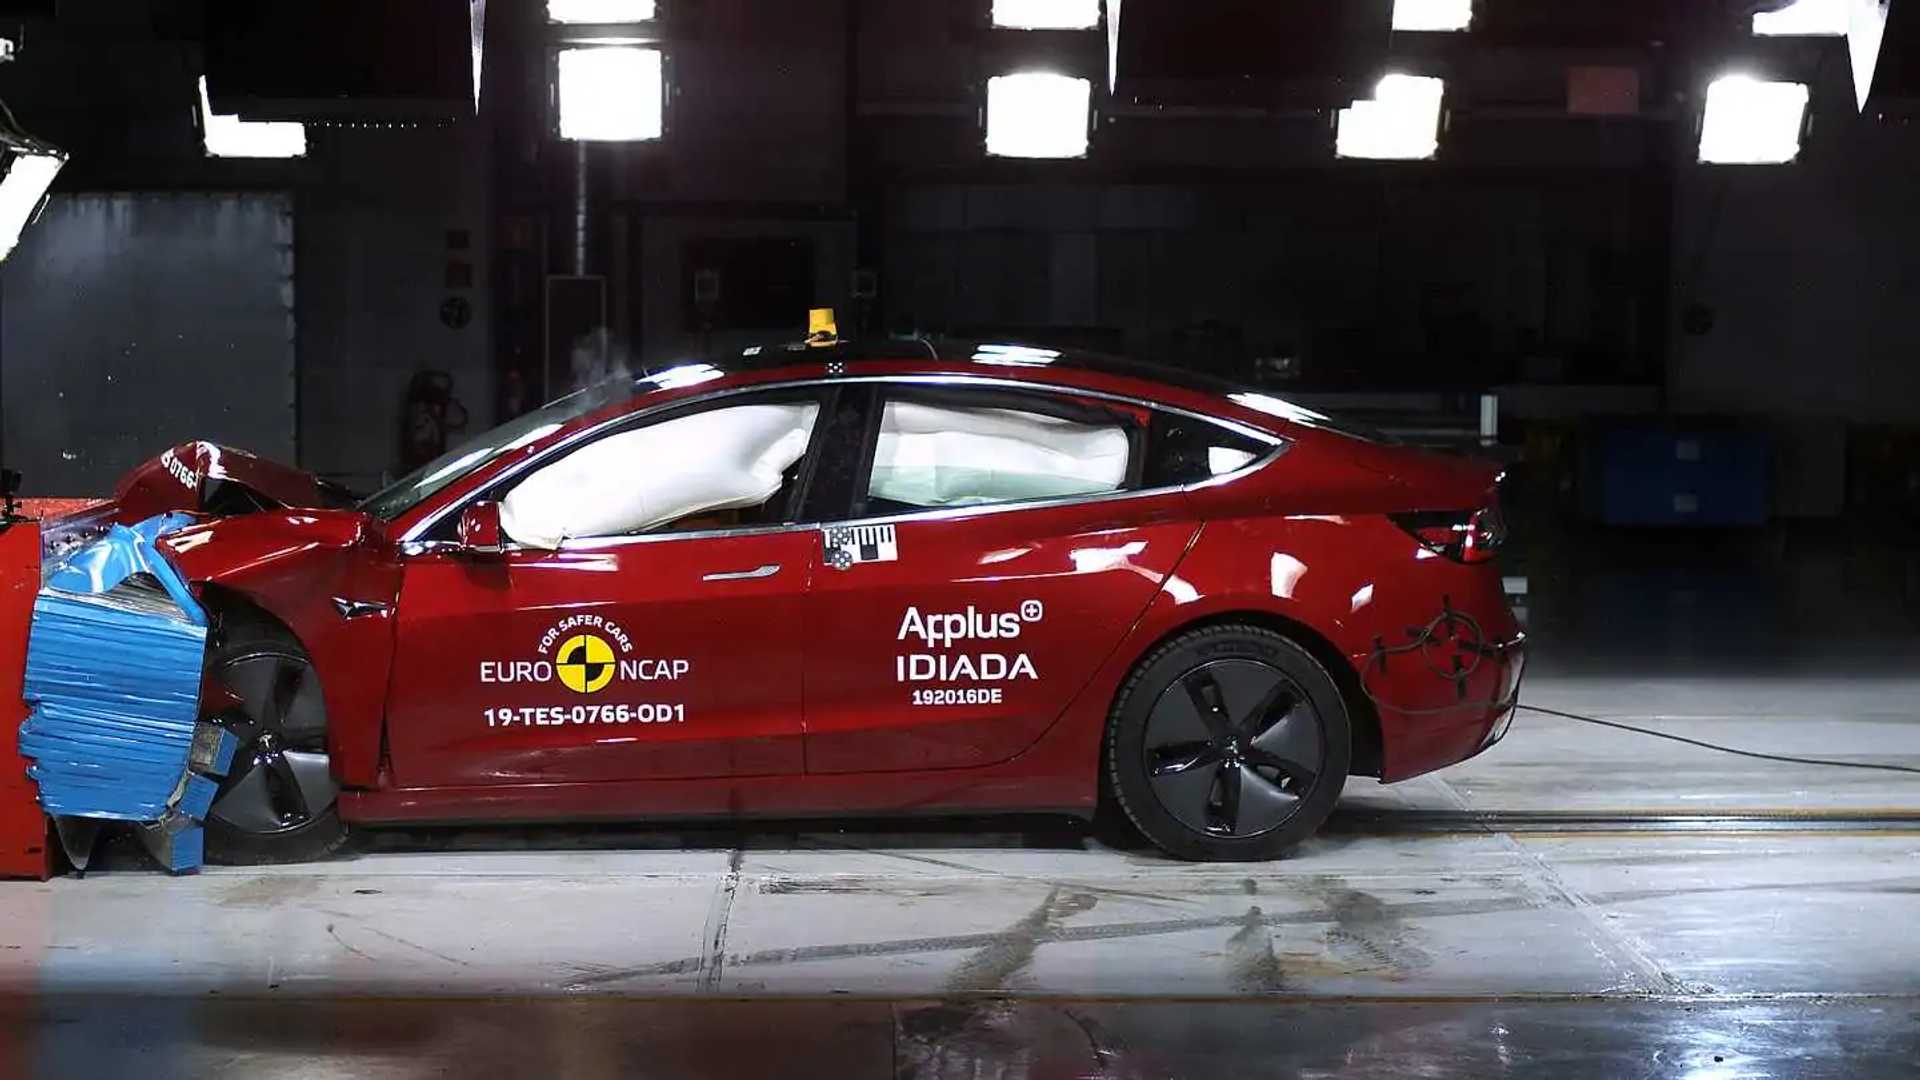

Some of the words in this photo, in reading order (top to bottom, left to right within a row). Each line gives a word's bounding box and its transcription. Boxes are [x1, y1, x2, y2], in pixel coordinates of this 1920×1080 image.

[537, 627, 560, 655] FOR
[558, 614, 603, 632] SAFER
[604, 621, 633, 653] CARS
[480, 661, 552, 683] EURO
[619, 659, 690, 680] NCAP
[896, 653, 1039, 682] IDIADA
[911, 688, 1003, 705] 192016DE
[484, 703, 686, 726] 19-TES-0766-OD1
